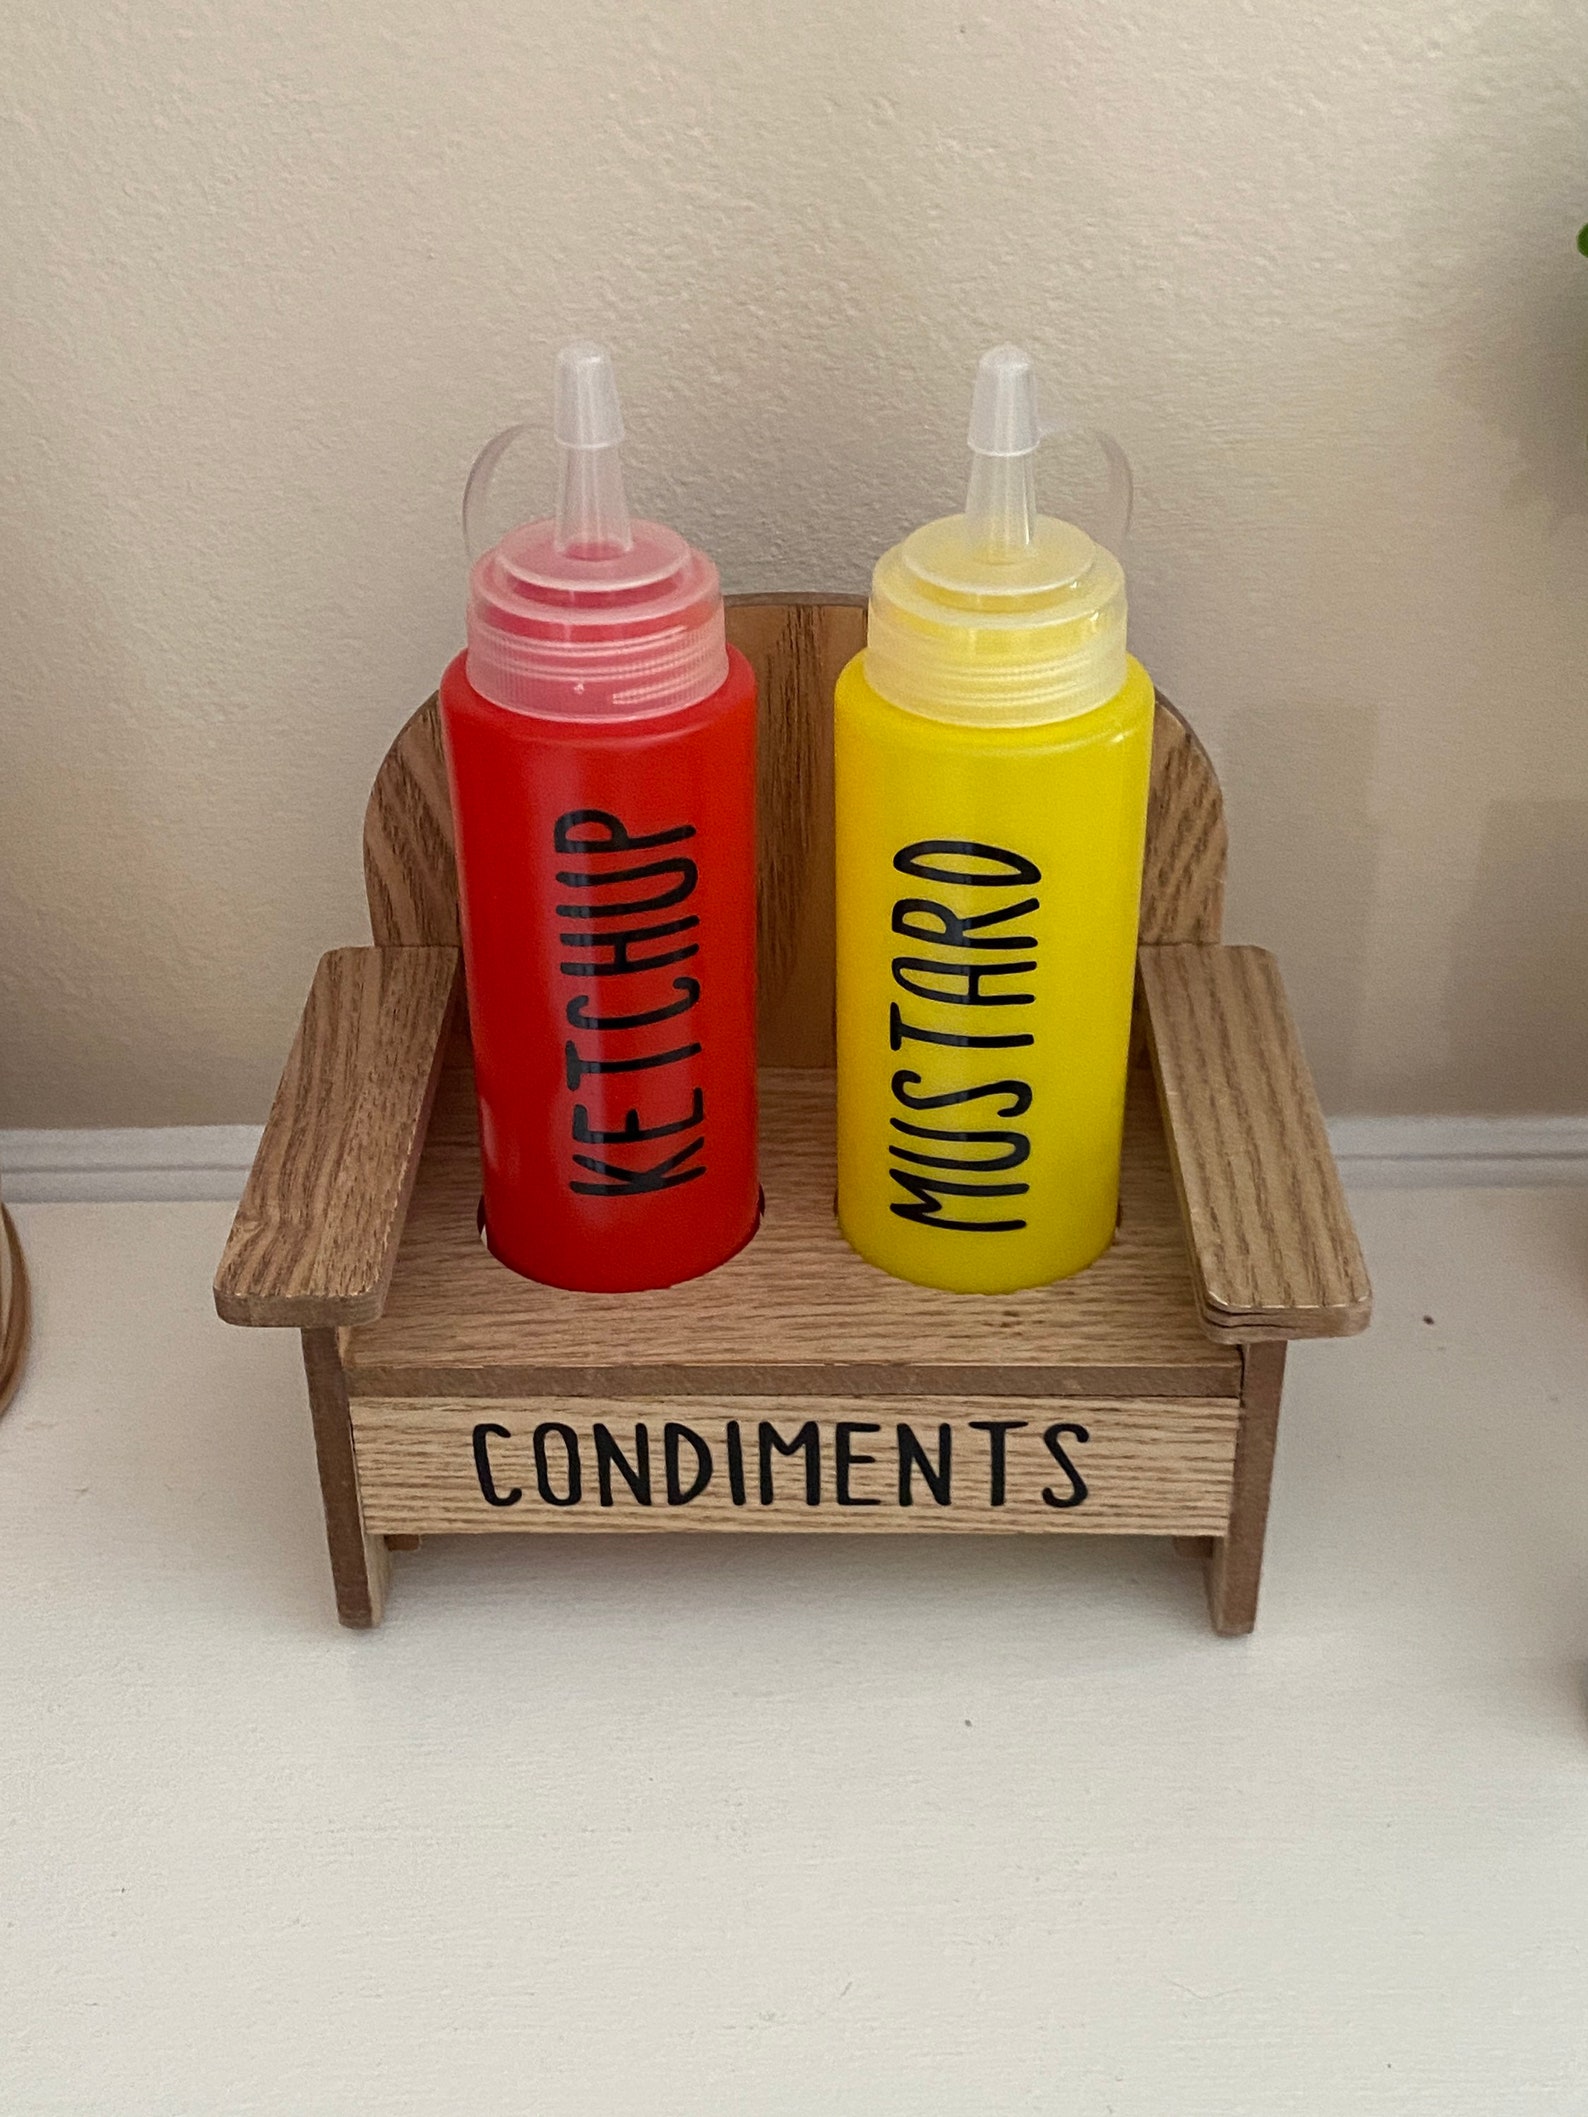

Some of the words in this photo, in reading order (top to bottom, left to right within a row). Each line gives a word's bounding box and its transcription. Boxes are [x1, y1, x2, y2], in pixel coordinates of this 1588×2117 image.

[553, 808, 708, 1198] KETCHUP
[888, 839, 1042, 1233] MUSTARD
[472, 1420, 1090, 1509] CONDIMENTS
